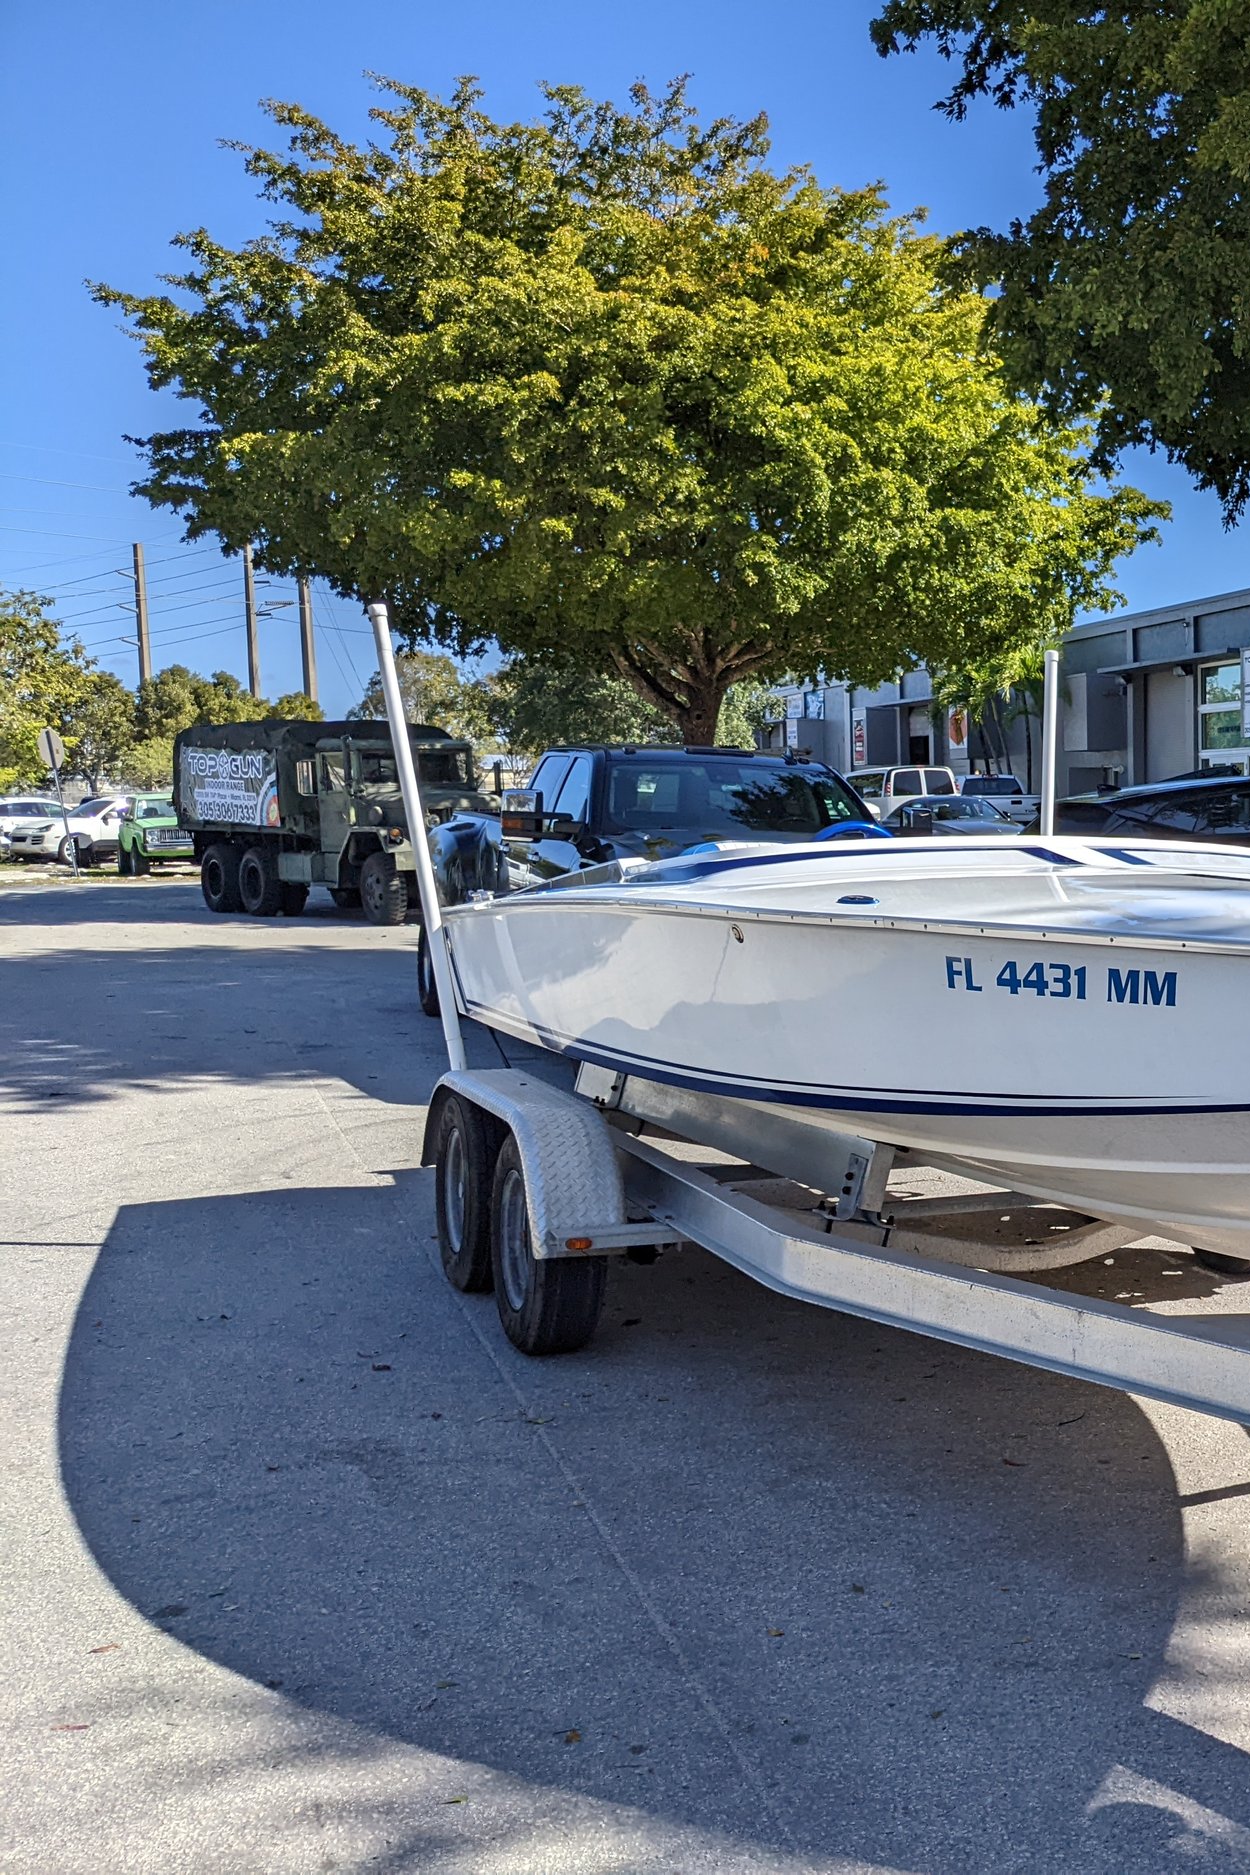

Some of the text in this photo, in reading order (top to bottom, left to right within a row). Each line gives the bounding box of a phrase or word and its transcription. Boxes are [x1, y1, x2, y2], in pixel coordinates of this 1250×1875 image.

[189, 753, 262, 778] TOP GUN
[225, 781, 244, 791] RANGE
[946, 956, 1177, 1006] FL 4431 MM
